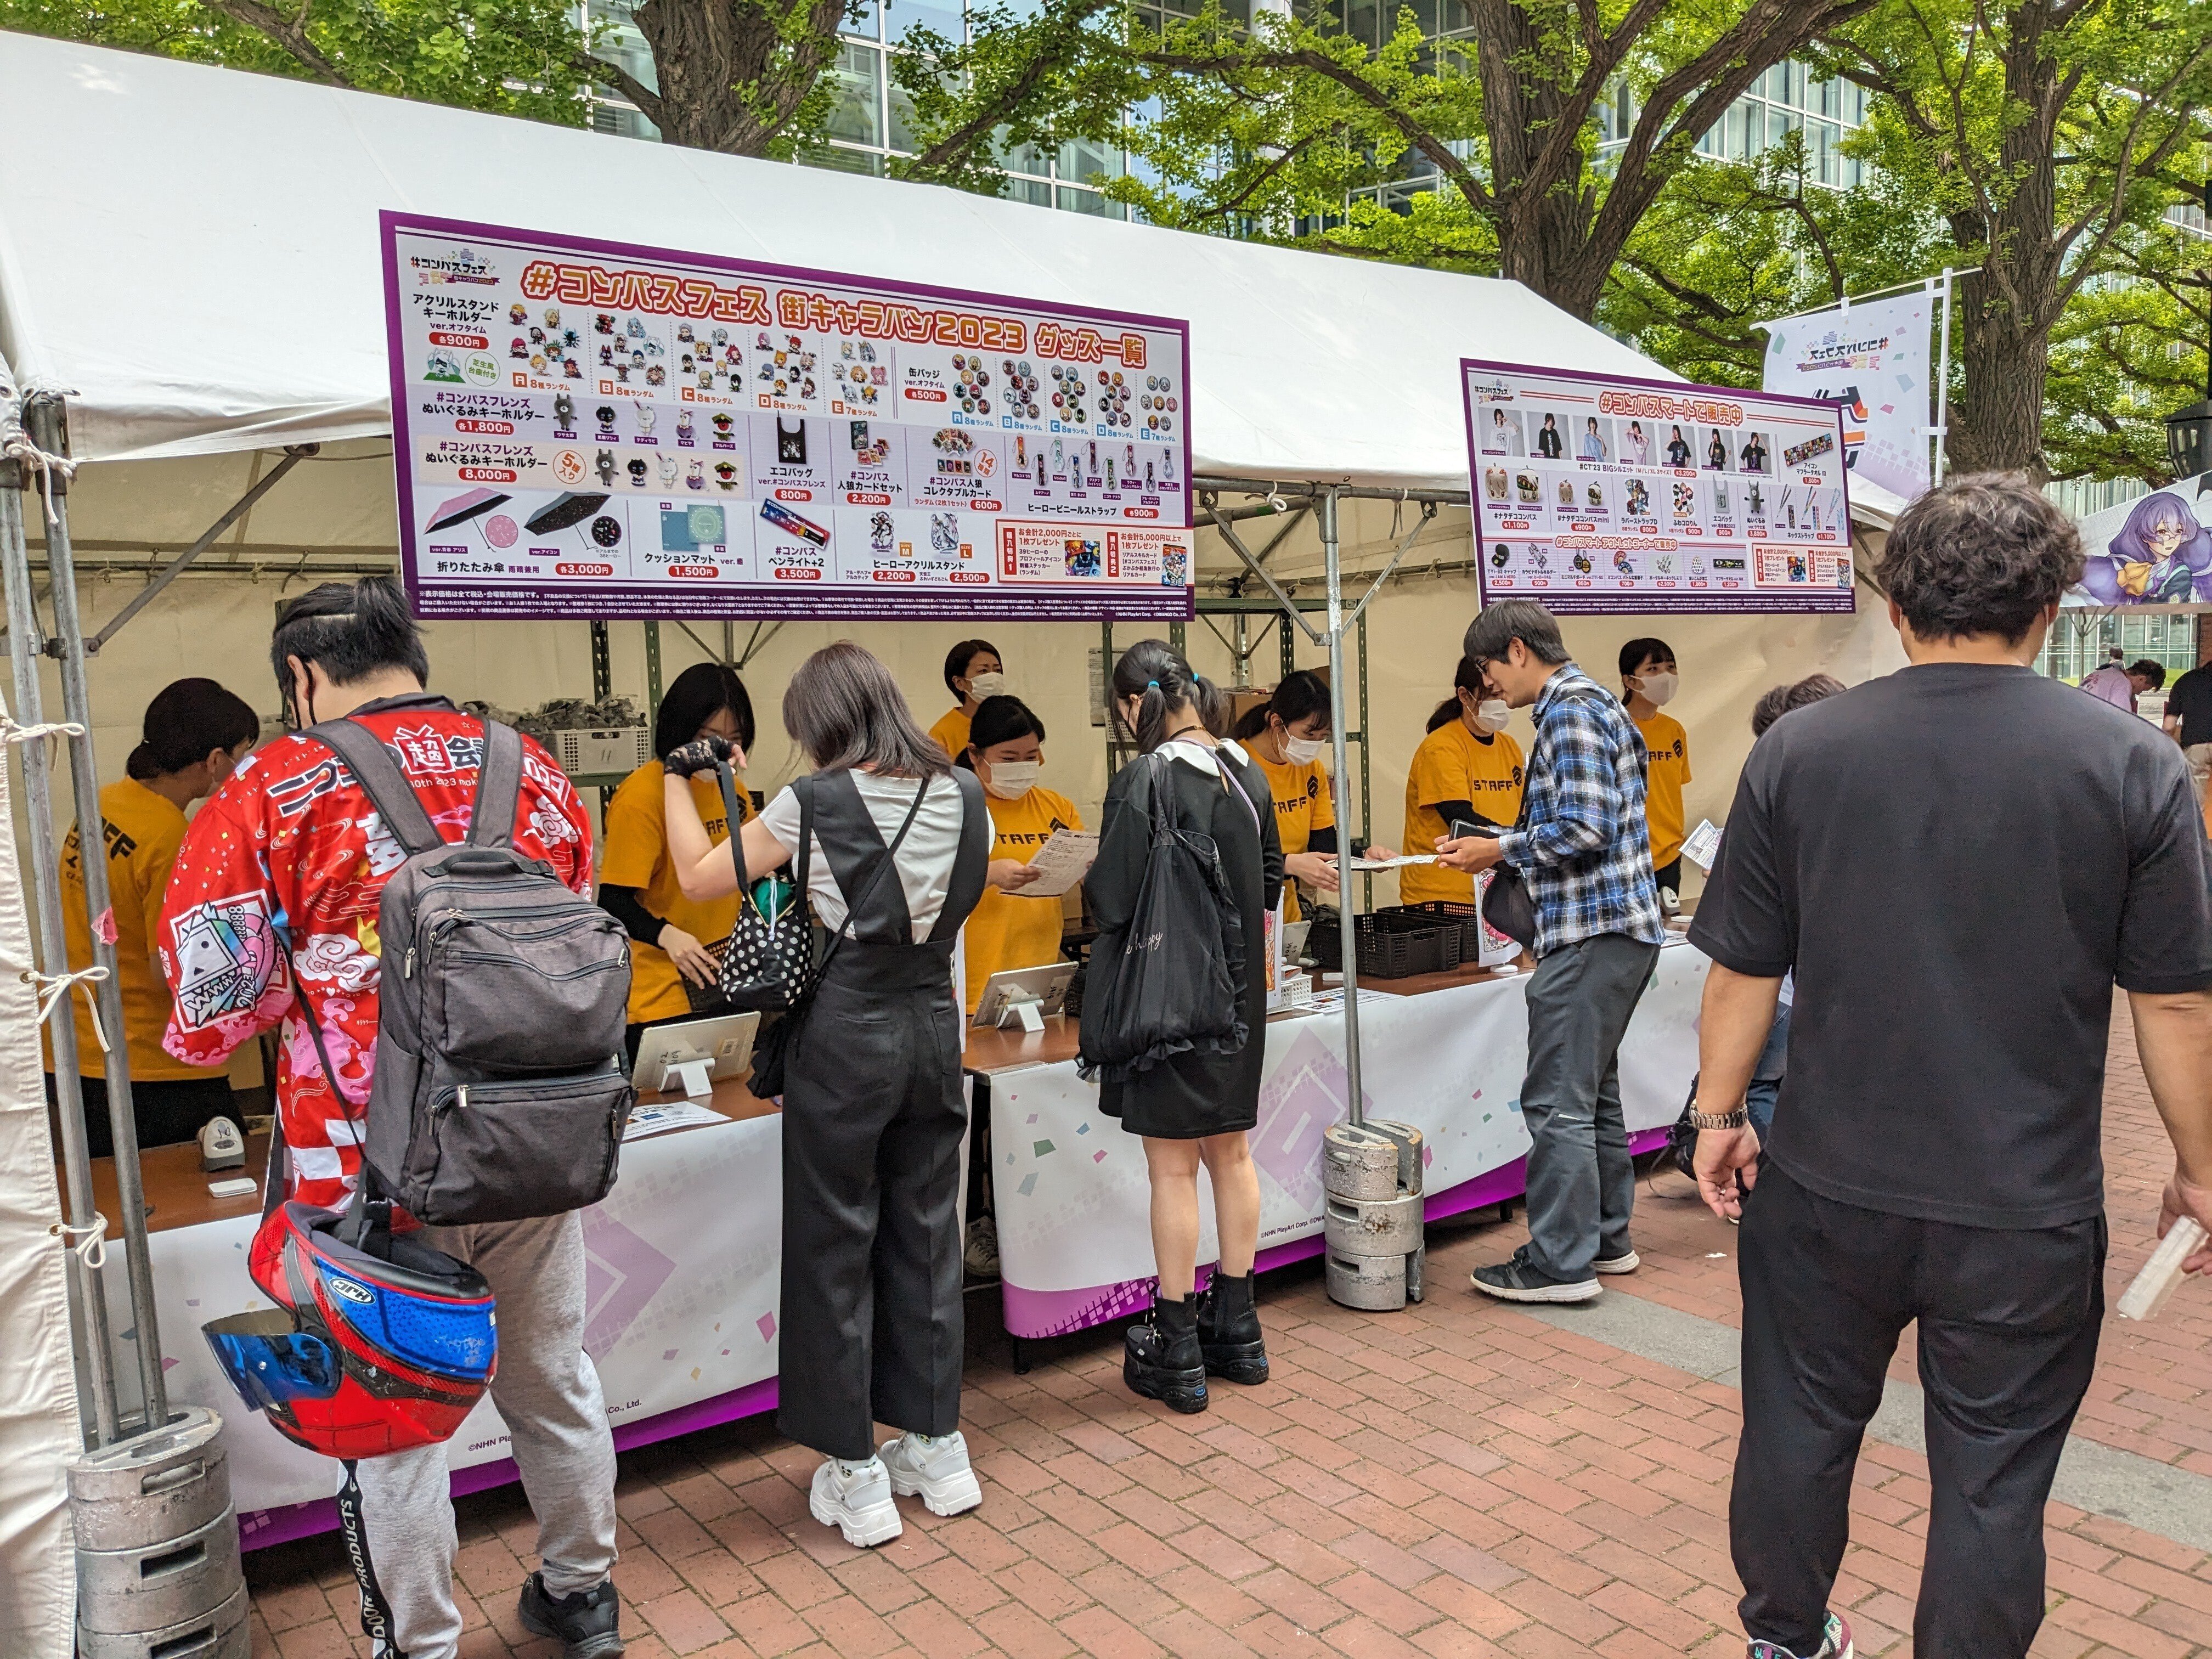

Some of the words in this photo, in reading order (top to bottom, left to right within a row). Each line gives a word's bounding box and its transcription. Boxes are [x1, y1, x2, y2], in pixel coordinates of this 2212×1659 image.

[410, 256, 488, 275] #コンパスフェス
[413, 294, 499, 312] アクリルスタンド
[424, 307, 492, 322] キーホルダー
[524, 263, 769, 324] #コンパスフェス
[779, 290, 1026, 354] 街キャラバン2023
[1036, 323, 1147, 369] グッズ一覧
[430, 323, 487, 334] ver.オフタイム
[439, 335, 480, 347] 各900円
[472, 358, 494, 370] 芝生風
[468, 366, 496, 379] 台座付き
[909, 368, 940, 379] 缶バッジ
[531, 380, 571, 391] 8種ランダム
[905, 380, 945, 389] ver.オフタイム
[616, 386, 654, 398] 8種ランダム
[912, 390, 941, 400] 各500円
[436, 392, 531, 409] #コンパスフレンズ
[697, 394, 733, 404] 8種ランダム
[774, 400, 808, 411] 8種ランダム
[1599, 391, 1743, 426] #コンパスマートで販売中
[422, 403, 545, 421] ぬいぐるみキーホルダー
[846, 407, 878, 417] 7種ランダム
[459, 421, 511, 433] 各1,800円
[965, 417, 994, 427] 8種ランダム
[1014, 421, 1042, 431] 8種ランダム
[1062, 426, 1089, 436] 8種ランダム
[1108, 430, 1134, 439] 8種ランダム
[1152, 433, 1177, 443] 7種ランダム
[439, 441, 533, 456] #コンパスフレンズ
[426, 452, 548, 469] ぬいぐるみキーホルダー
[465, 469, 510, 480] 8,000円
[558, 467, 575, 480] 入り
[770, 467, 813, 477] エコバッグ
[850, 471, 890, 482] #コンパス
[758, 478, 826, 488] ver.#コンパスフレンズ
[838, 481, 903, 493] 人狼カードセット
[930, 477, 983, 488] #コンパス人狼
[781, 490, 807, 500] 800円
[924, 487, 991, 498] コレクタブルカード
[852, 494, 886, 504] 2,200円
[975, 501, 998, 510] 600円
[1028, 503, 1116, 516] ヒーロービニールストラップ
[1130, 509, 1154, 518] 各900円
[1018, 528, 1081, 538] お会計2,000円ごとに
[1121, 533, 1182, 542] お会計5,000円以上で
[1019, 538, 1060, 546] 1枚プレゼント
[775, 546, 817, 556] #コンパス
[644, 553, 715, 565] クッションマット
[768, 558, 825, 567] ペンライト+2
[437, 561, 505, 573] 折りたたみ傘
[508, 565, 540, 574] 雨晴兼用
[560, 565, 609, 575] 各3,000円
[873, 560, 965, 570] ヒーローアクリルスタンド
[675, 567, 713, 577] 1,500円
[780, 569, 816, 578] 3,500円
[877, 572, 911, 580] 2,200円
[954, 573, 985, 582] 2,500円
[1648, 751, 1672, 761] AFF
[1474, 779, 1514, 792] STAFF
[1273, 795, 1307, 814] AFF
[995, 833, 1049, 844] TAFF
[1135, 932, 1163, 954] happy
[1277, 1223, 1295, 1234] PlayArt
[1310, 1215, 1325, 1224] ©DWA
[469, 1438, 496, 1452] ©NHN
[608, 1406, 625, 1414] Co.,
[627, 1400, 642, 1409] Ltd.
[341, 1498, 371, 1589] PRODUCTS
